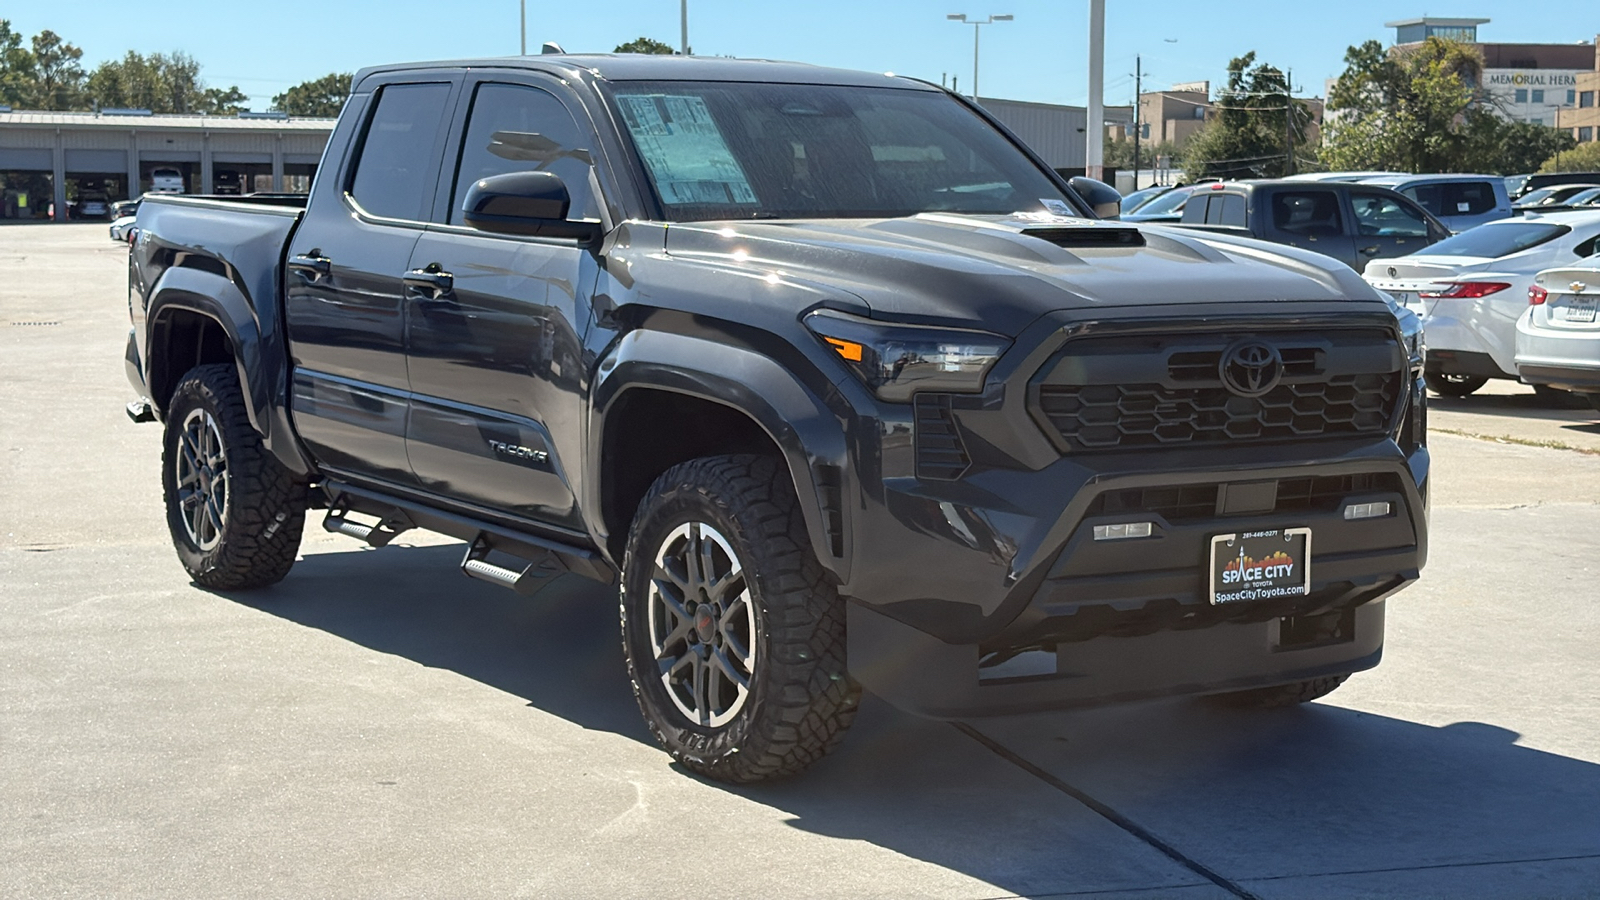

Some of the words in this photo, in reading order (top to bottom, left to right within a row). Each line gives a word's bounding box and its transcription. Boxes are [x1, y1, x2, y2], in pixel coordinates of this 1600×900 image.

[1489, 74, 1546, 85] MEMORIAL
[488, 439, 548, 463] TACOMA
[1222, 565, 1262, 583] SPACE
[1265, 564, 1293, 578] CITY
[1252, 580, 1273, 588] TOYOTA
[1215, 586, 1304, 603] SpaceCityToyota.com
